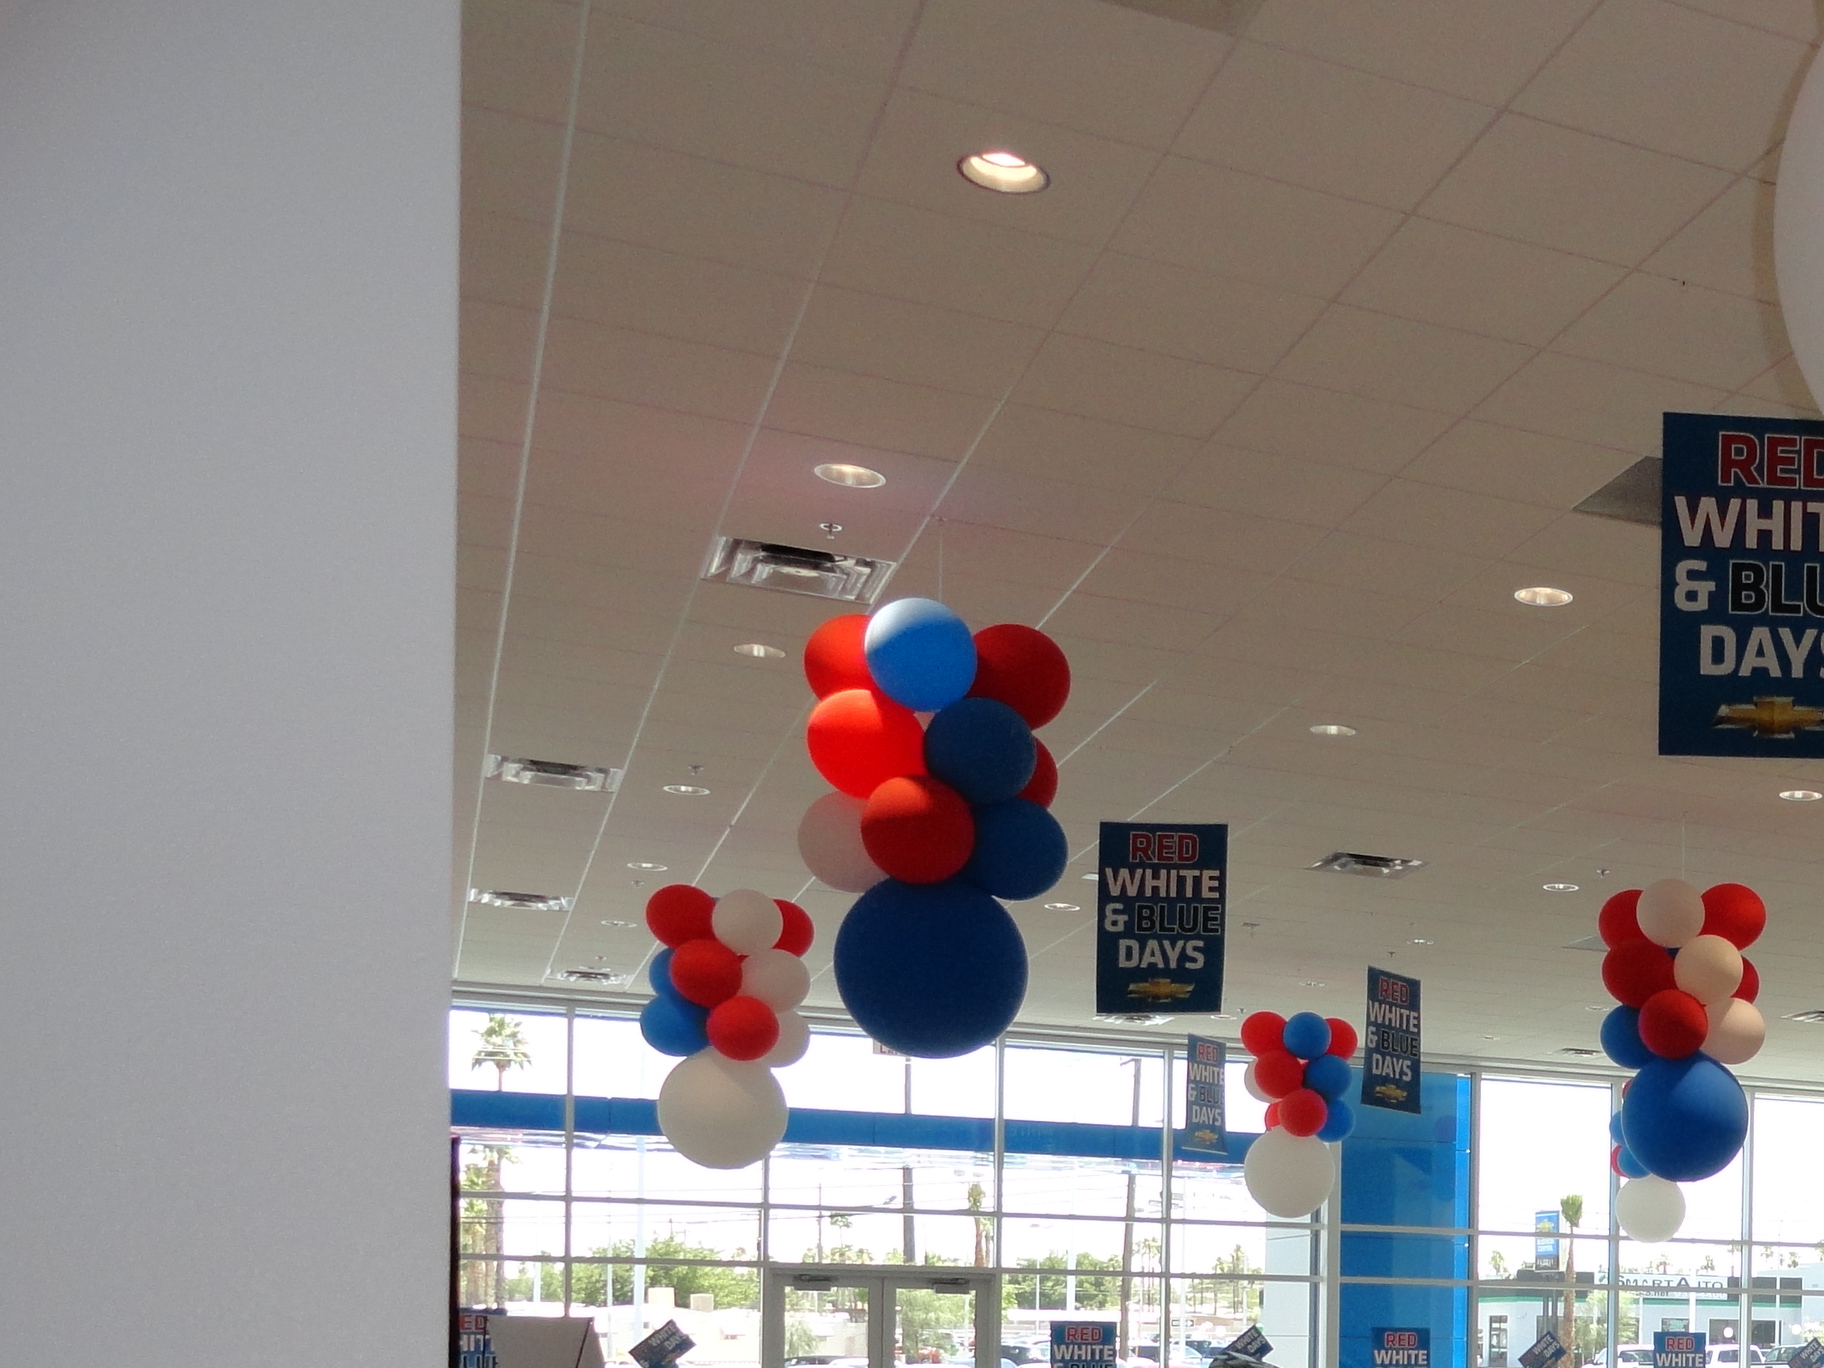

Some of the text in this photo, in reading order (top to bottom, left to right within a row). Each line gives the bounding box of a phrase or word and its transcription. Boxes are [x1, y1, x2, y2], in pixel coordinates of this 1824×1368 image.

[1674, 560, 1716, 612] &
[1130, 831, 1198, 863] RED
[1105, 868, 1219, 898] WHITE
[1105, 903, 1221, 934] & BLUE
[1119, 939, 1204, 969] DAYS
[1379, 976, 1409, 1005] RED
[1369, 1000, 1418, 1032] WHITE
[1197, 1042, 1218, 1063] RED
[1367, 1026, 1419, 1058] & BLUE
[1189, 1063, 1224, 1085] WHITE
[1372, 1054, 1412, 1081] DAYS
[1188, 1084, 1196, 1101] &
[1192, 1106, 1221, 1126] DAYS
[460, 1315, 488, 1331] ED
[1066, 1326, 1102, 1342] RED
[1385, 1332, 1417, 1348] RED
[1666, 1337, 1694, 1351] RED
[1053, 1344, 1113, 1360] WHITE
[1374, 1350, 1427, 1364] WHITE
[1656, 1353, 1704, 1367] WHITE
